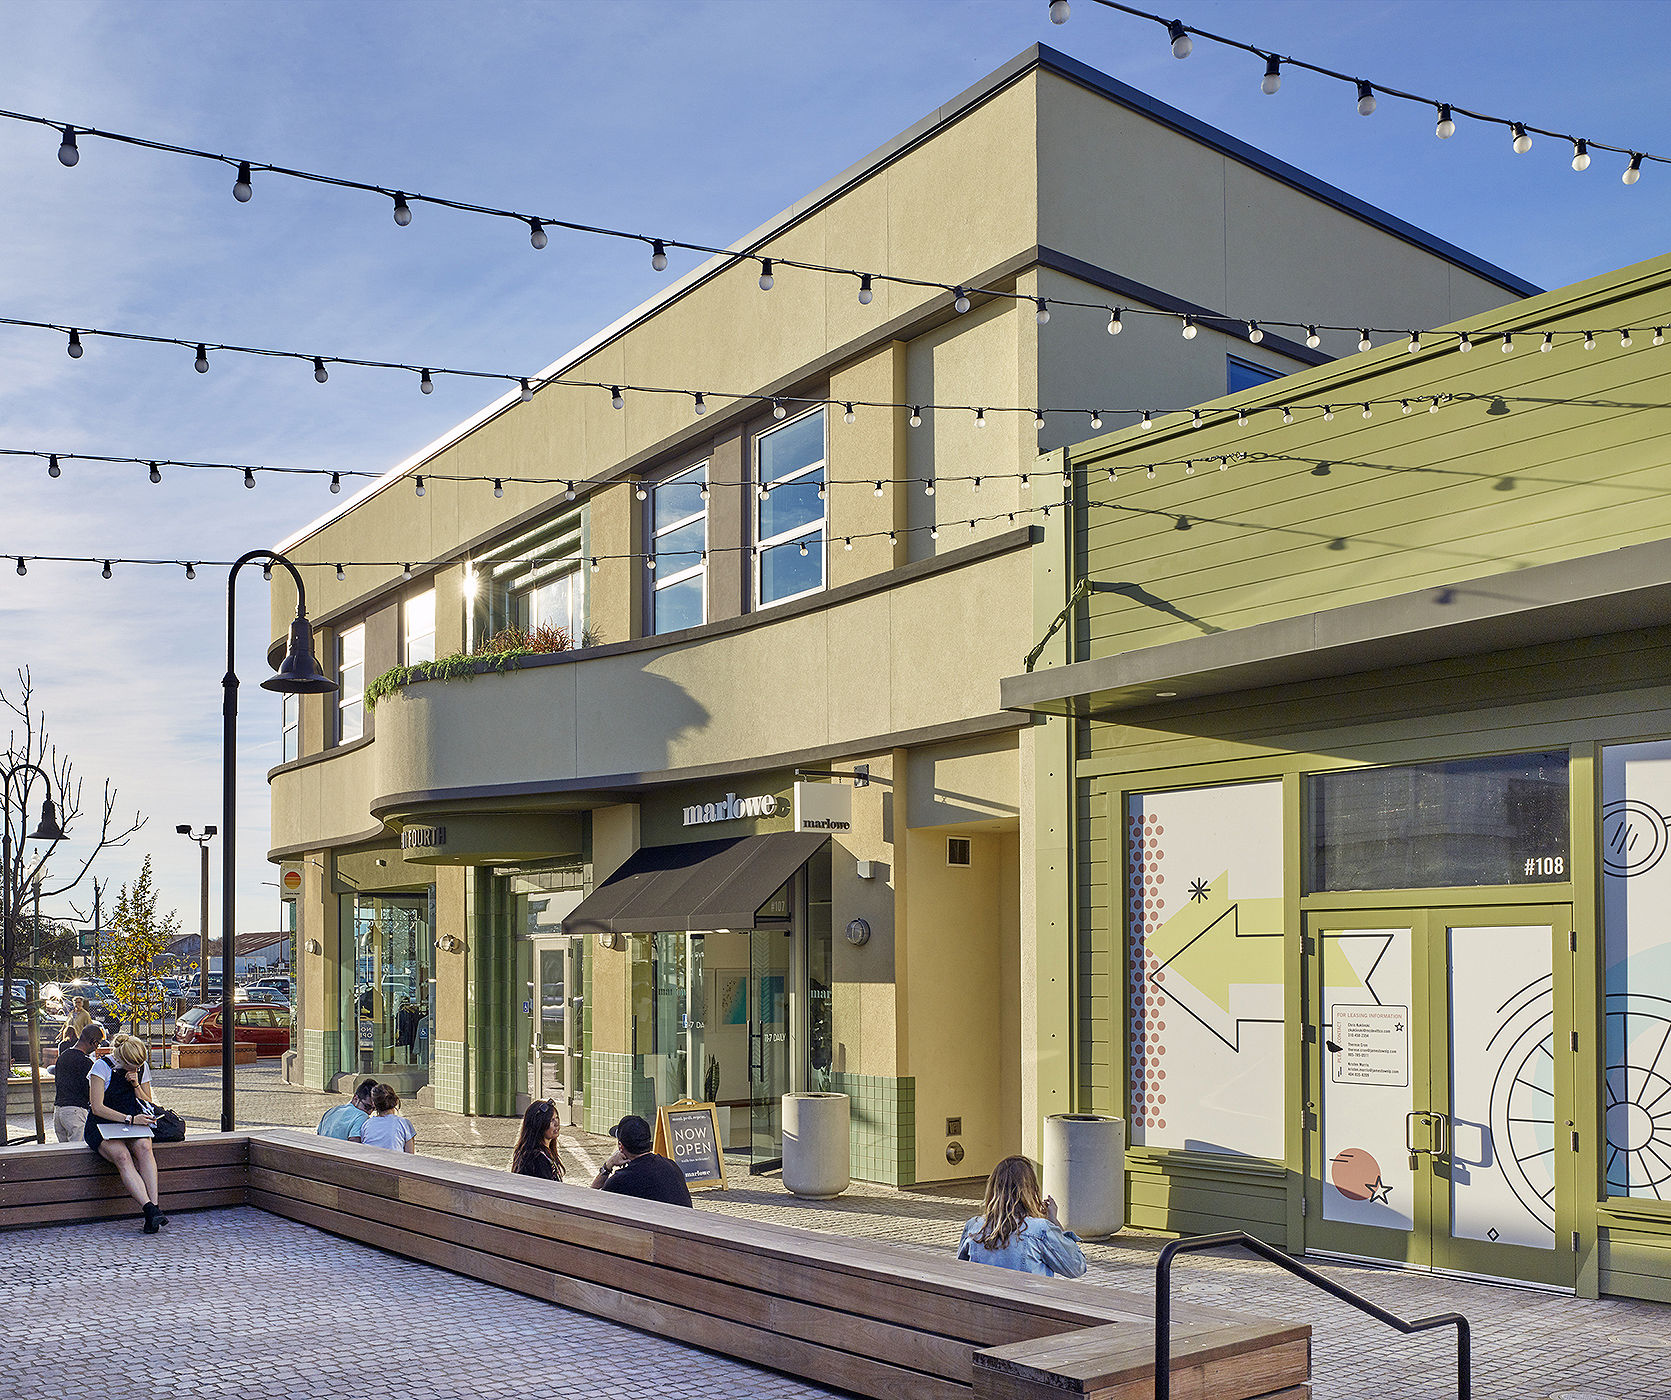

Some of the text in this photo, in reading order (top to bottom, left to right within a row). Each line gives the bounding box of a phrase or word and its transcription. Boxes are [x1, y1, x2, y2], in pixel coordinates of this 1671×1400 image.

[682, 792, 776, 827] marlowe
[803, 818, 851, 830] marlowe
[408, 826, 447, 848] FOURTH
[1524, 856, 1564, 876] #108
[771, 900, 785, 912] #107
[674, 1127, 707, 1141] NOW
[675, 1141, 712, 1156] OPEN
